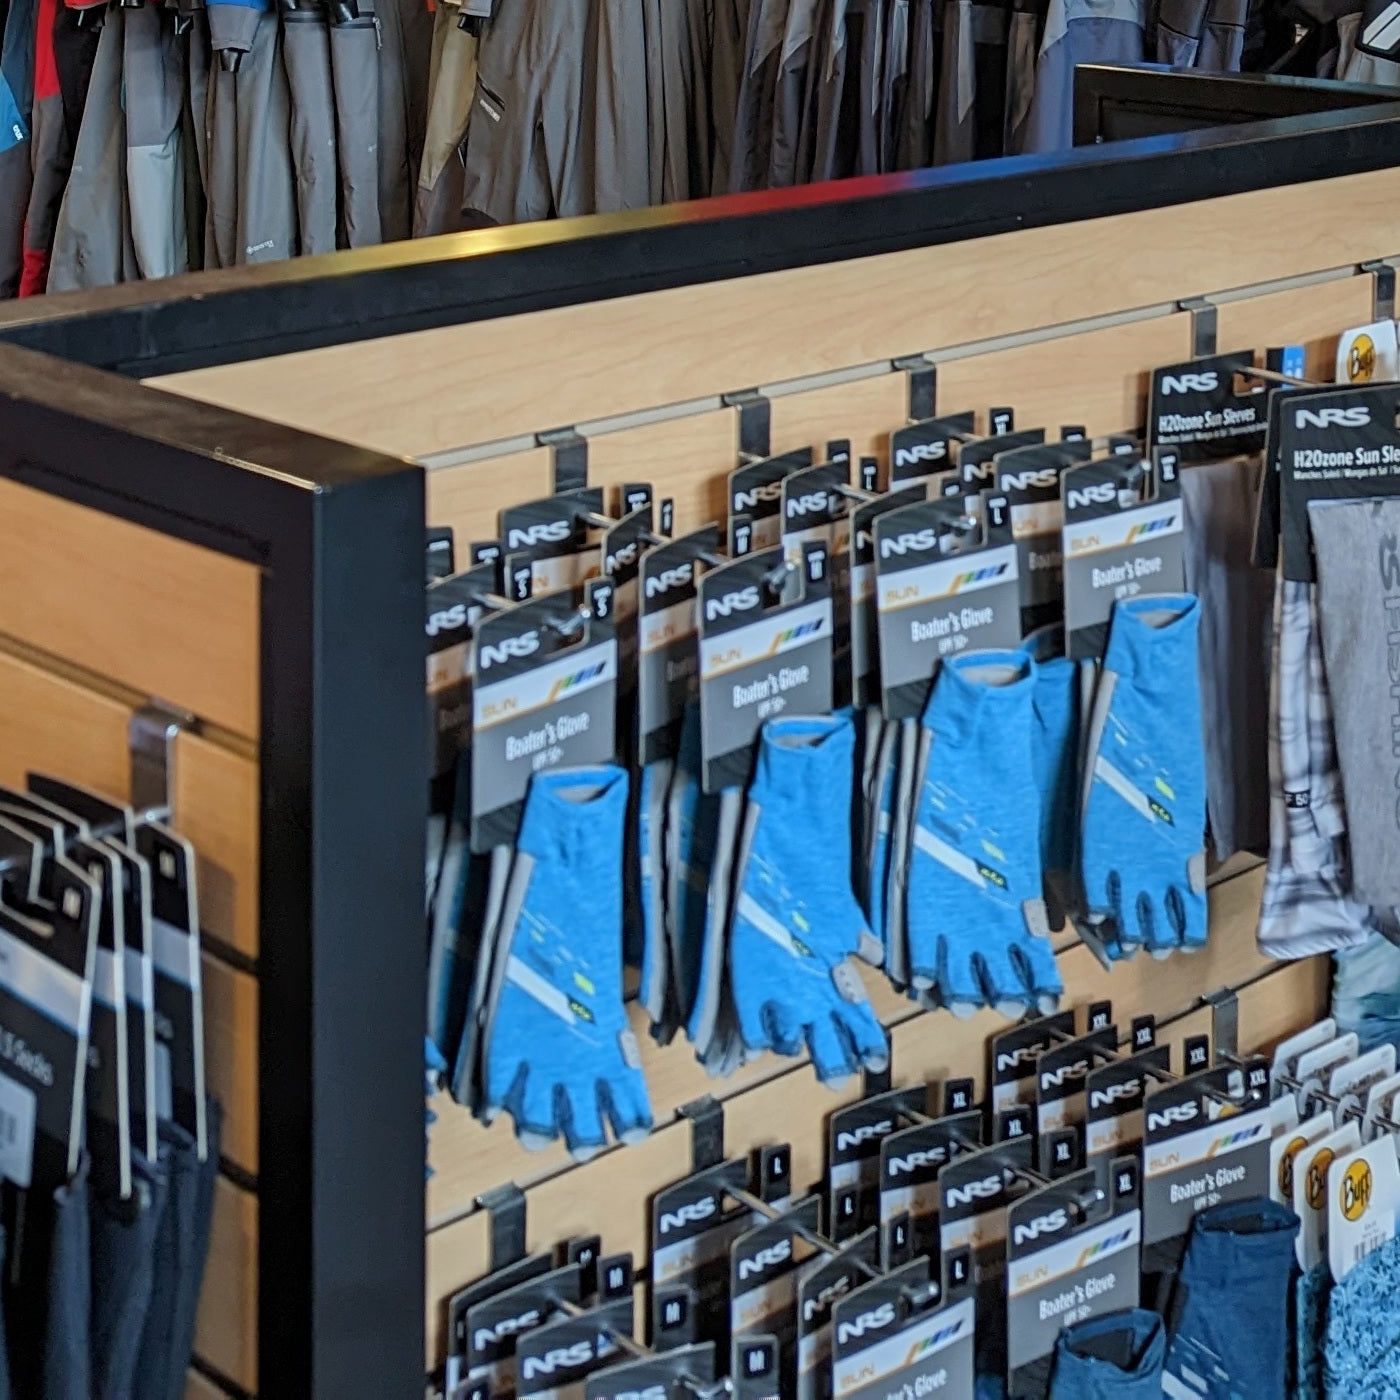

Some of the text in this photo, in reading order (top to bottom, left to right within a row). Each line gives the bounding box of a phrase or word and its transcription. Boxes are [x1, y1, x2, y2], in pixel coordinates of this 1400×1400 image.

[1162, 371, 1218, 396] NRS
[1205, 411, 1222, 428] Sun
[1223, 408, 1256, 425] Sleeves
[1296, 407, 1372, 429] NRS
[896, 441, 945, 467] NRS
[1355, 447, 1380, 465] Sun
[1001, 468, 1058, 493] NRS
[787, 491, 828, 518] NRS
[1067, 482, 1117, 510] NRS
[509, 520, 571, 548] NRS
[881, 528, 936, 558] NRS
[646, 563, 692, 598] NRS
[1092, 556, 1162, 589] Boater's Glove
[707, 586, 760, 621] NRS
[910, 607, 993, 642] Boater's Glove
[481, 631, 540, 668] NRS
[733, 665, 810, 708] Boater's Glove
[505, 710, 590, 761] Boater's Glove
[1136, 1027, 1152, 1044] XXL
[998, 1043, 1045, 1071] NRS
[1190, 1047, 1206, 1065] XXL
[1041, 1060, 1089, 1090] NRS
[1250, 1069, 1266, 1086] XXL
[953, 1091, 967, 1108] XL
[1091, 1079, 1141, 1109] NRS
[1008, 1119, 1023, 1136] XL
[1148, 1100, 1198, 1131] NRS
[838, 1120, 893, 1150] NRS
[774, 1157, 782, 1174] L
[889, 1146, 946, 1176] NRS
[1057, 1142, 1071, 1161] XL
[1150, 1152, 1180, 1170] SUN
[947, 1175, 1003, 1208] NRS
[1119, 1173, 1132, 1193] XL
[1170, 1165, 1246, 1204] Boater's Glove
[660, 1197, 716, 1234] NRS
[845, 1197, 853, 1214] L
[1014, 1208, 1068, 1245] NRS
[739, 1238, 791, 1280] NRS
[955, 1260, 963, 1279] L
[804, 1276, 849, 1321] NRS
[1039, 1272, 1116, 1320] Boater's Glove
[666, 1302, 680, 1324] M
[838, 1302, 896, 1344] NRS
[475, 1310, 540, 1351] NRS
[523, 1341, 594, 1380] NRS
[750, 1350, 765, 1372] M
[915, 1369, 947, 1397] Glove
